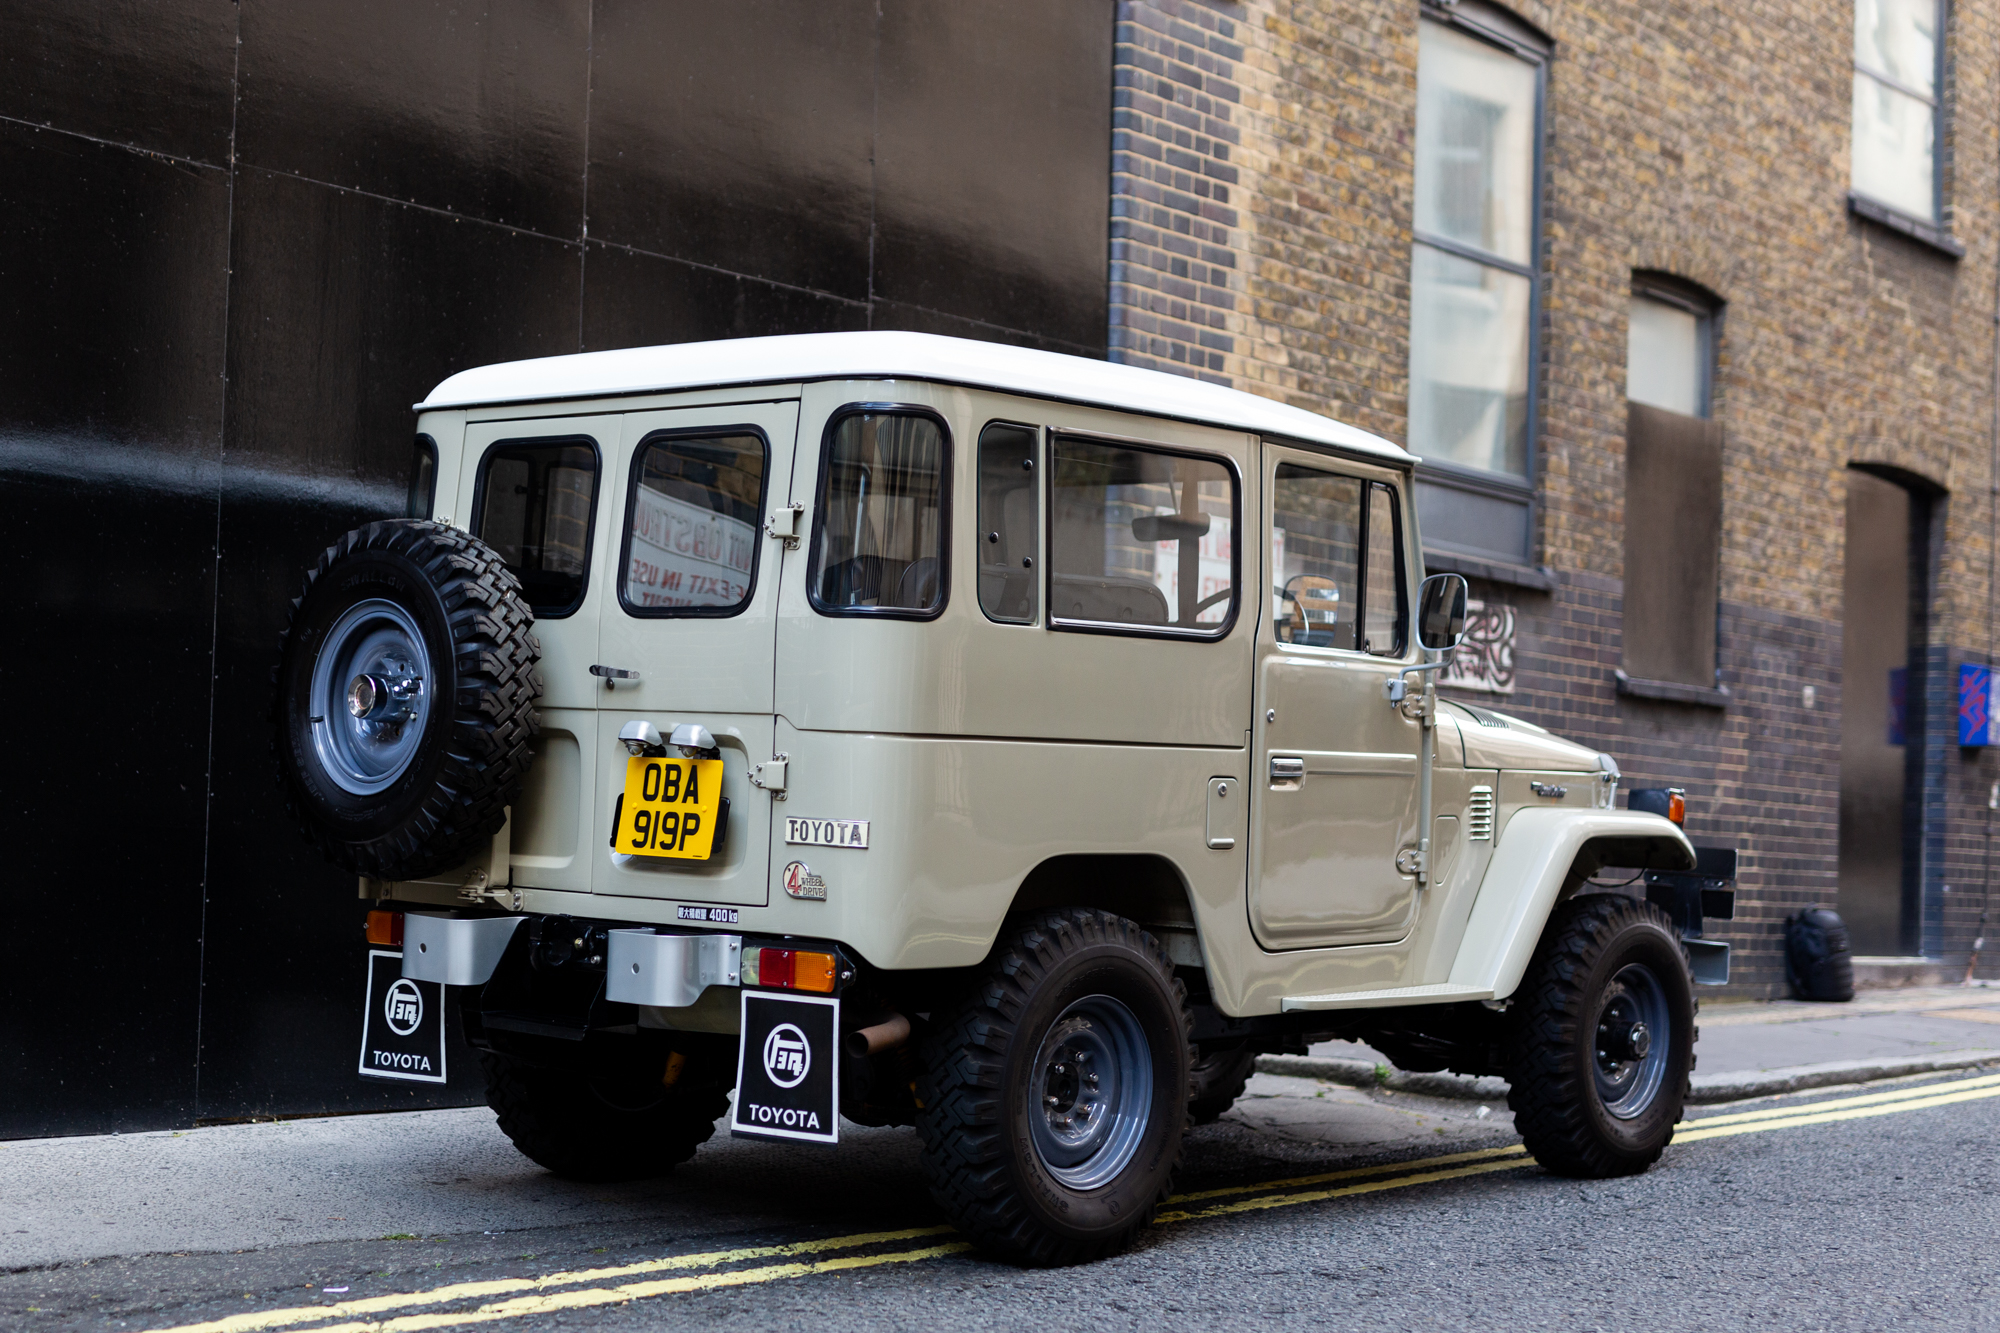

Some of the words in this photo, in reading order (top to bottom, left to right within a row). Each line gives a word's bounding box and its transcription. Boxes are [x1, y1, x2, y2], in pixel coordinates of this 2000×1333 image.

[642, 763, 699, 804] OBA
[631, 810, 701, 851] 919P
[788, 819, 863, 846] TOYOTA
[787, 864, 802, 895] 4
[802, 886, 825, 897] DRIVE
[373, 1050, 432, 1072] TOYOTA
[749, 1103, 820, 1130] TOYOTA
